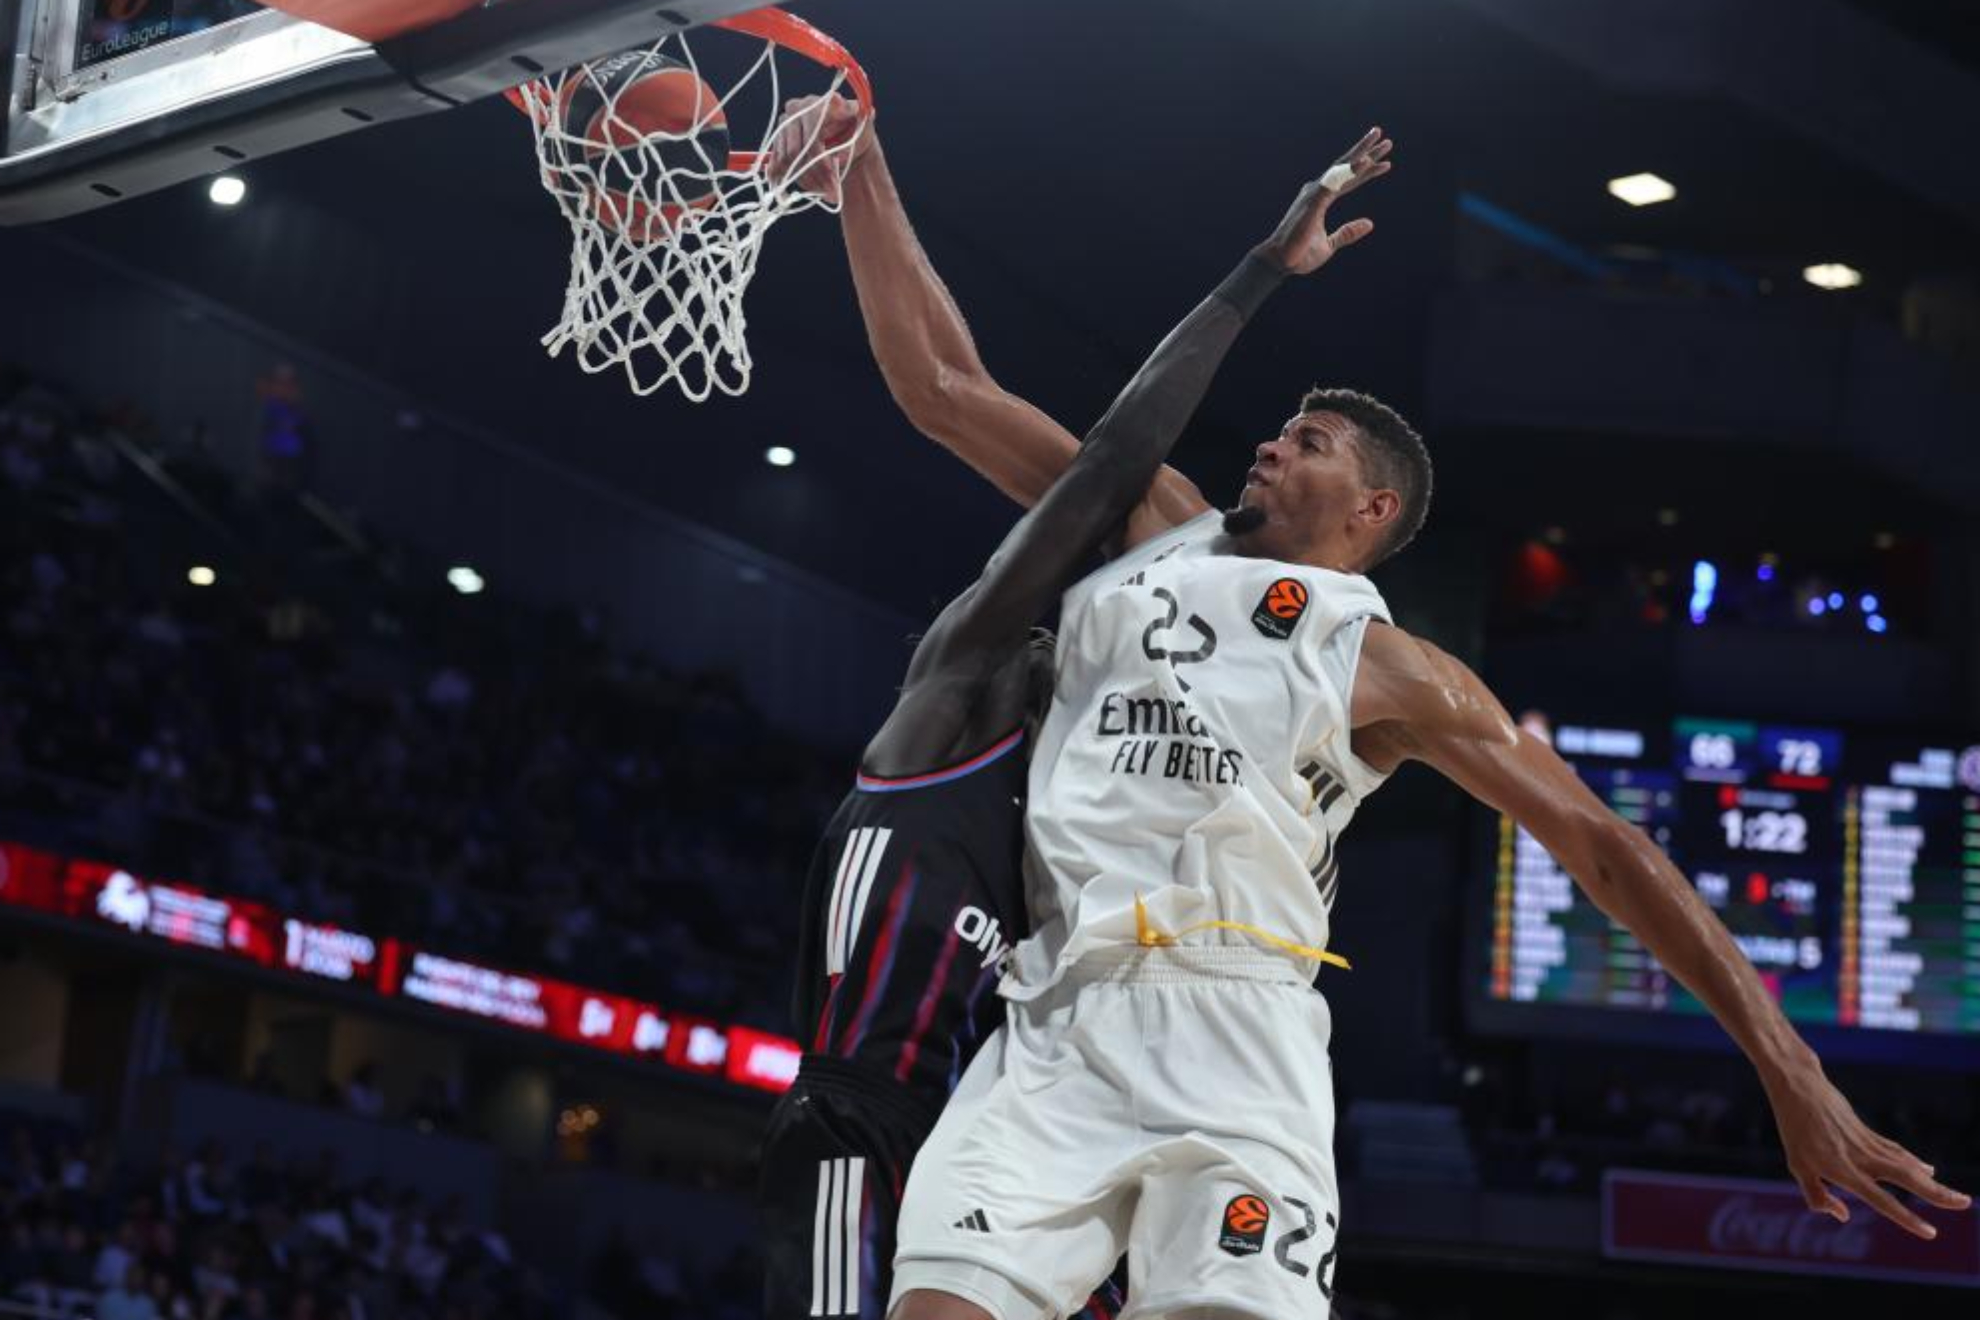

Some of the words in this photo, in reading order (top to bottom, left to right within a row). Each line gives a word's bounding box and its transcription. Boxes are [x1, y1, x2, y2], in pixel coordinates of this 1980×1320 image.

[81, 21, 169, 60] EuroLeague
[1111, 741, 1159, 774] FLY
[1775, 739, 1822, 776] 72
[1719, 809, 1807, 853] 1:22
[954, 905, 1010, 974] Oly
